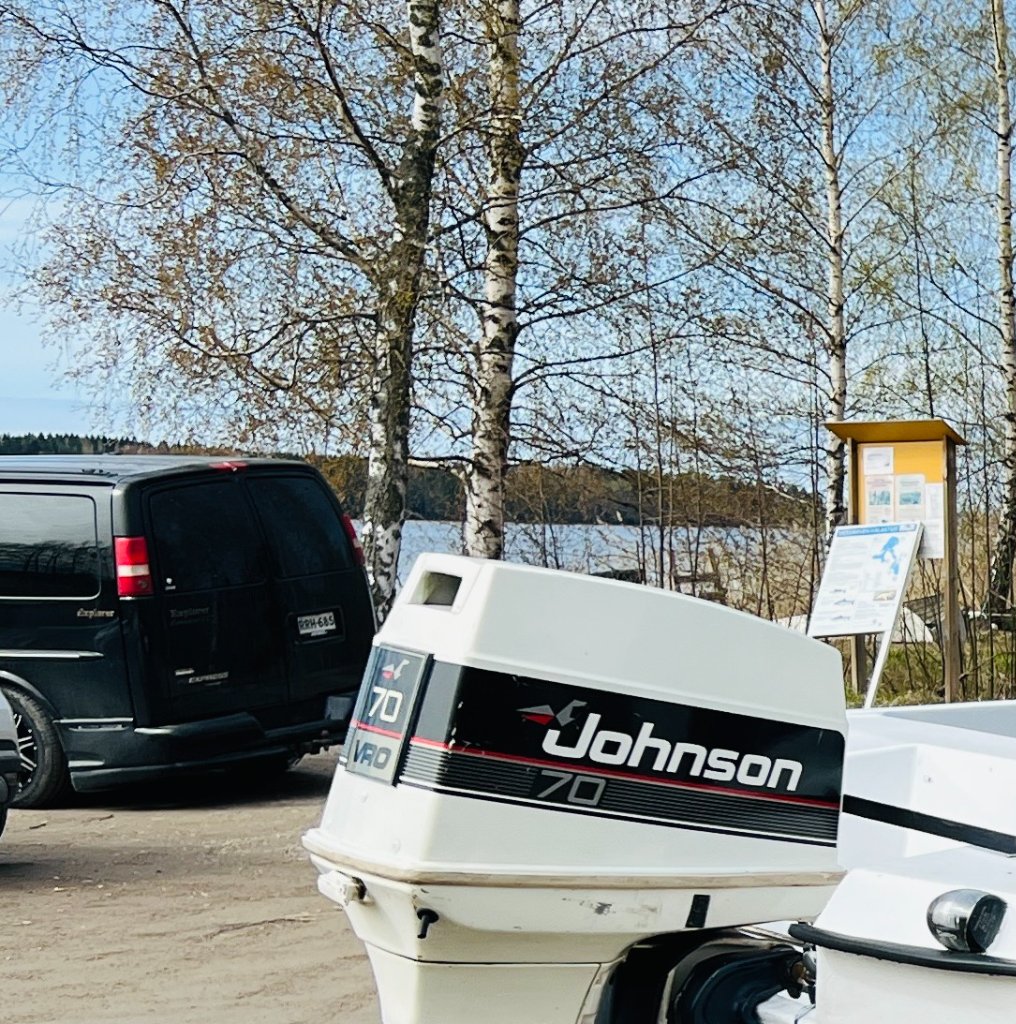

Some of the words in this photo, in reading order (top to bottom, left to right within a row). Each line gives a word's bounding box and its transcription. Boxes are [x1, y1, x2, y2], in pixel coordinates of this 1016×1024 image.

[368, 686, 403, 723] 70
[353, 739, 392, 770] VRO
[542, 712, 803, 792] Johnson
[535, 769, 607, 807] 70
